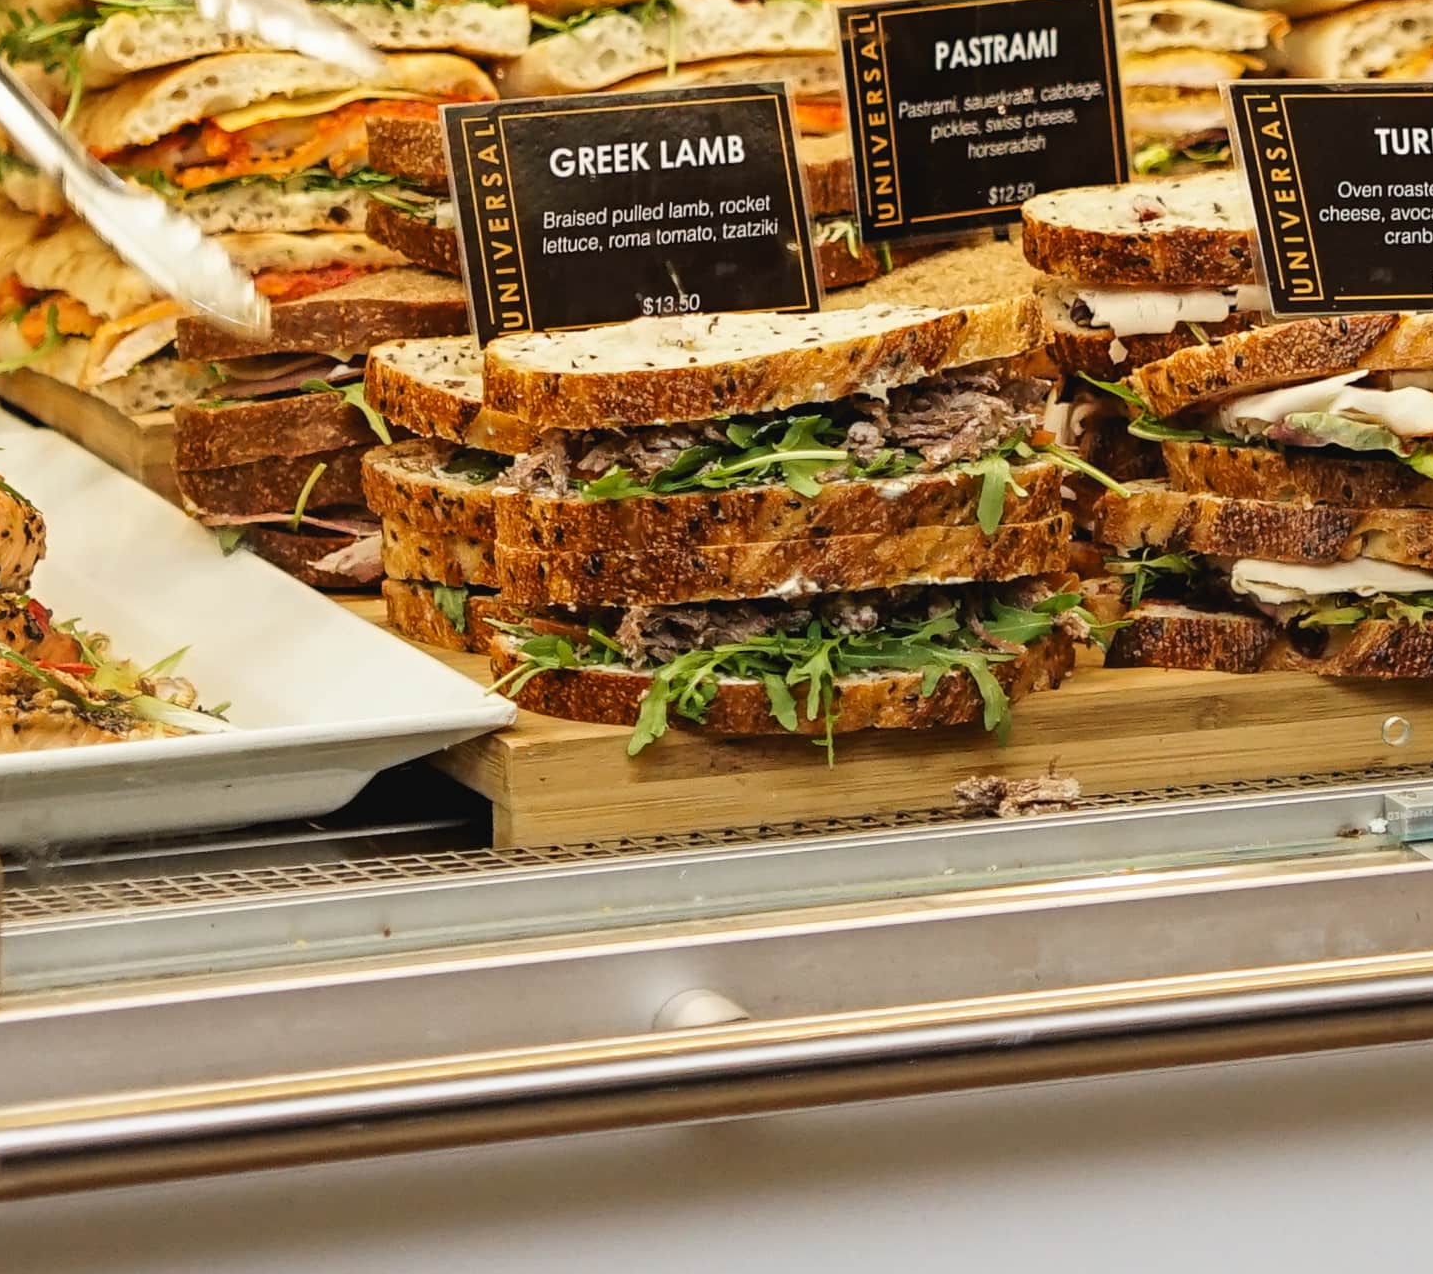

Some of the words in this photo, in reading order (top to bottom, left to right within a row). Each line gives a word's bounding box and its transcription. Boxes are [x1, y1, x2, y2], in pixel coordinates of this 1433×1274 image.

[934, 27, 1058, 71] PASTRAMI
[898, 95, 960, 119] Pastrami,
[1040, 80, 1104, 102] cabbage,
[858, 17, 896, 221] UNIVERSAL
[930, 119, 982, 143] pickles,
[985, 114, 1022, 133] swiss
[1024, 107, 1077, 129] cheese,
[548, 147, 652, 179] GREEK
[660, 134, 746, 169] LAMB
[968, 133, 1047, 160] horseradish
[988, 182, 1036, 207] $12.50
[1257, 100, 1315, 296] UNIVERSAL
[1337, 180, 1383, 199] Oven
[474, 122, 525, 329] UNIVERSAL
[542, 208, 608, 230] Braised
[611, 202, 664, 227] pulled
[668, 200, 715, 221] lamb,
[719, 195, 771, 215] rocket
[1318, 205, 1386, 224] cheese,
[542, 234, 604, 255] lettuce,
[608, 232, 652, 249] roma
[655, 225, 717, 245] tomato,
[722, 218, 779, 240] tzatziki
[642, 293, 701, 316] $13.50
